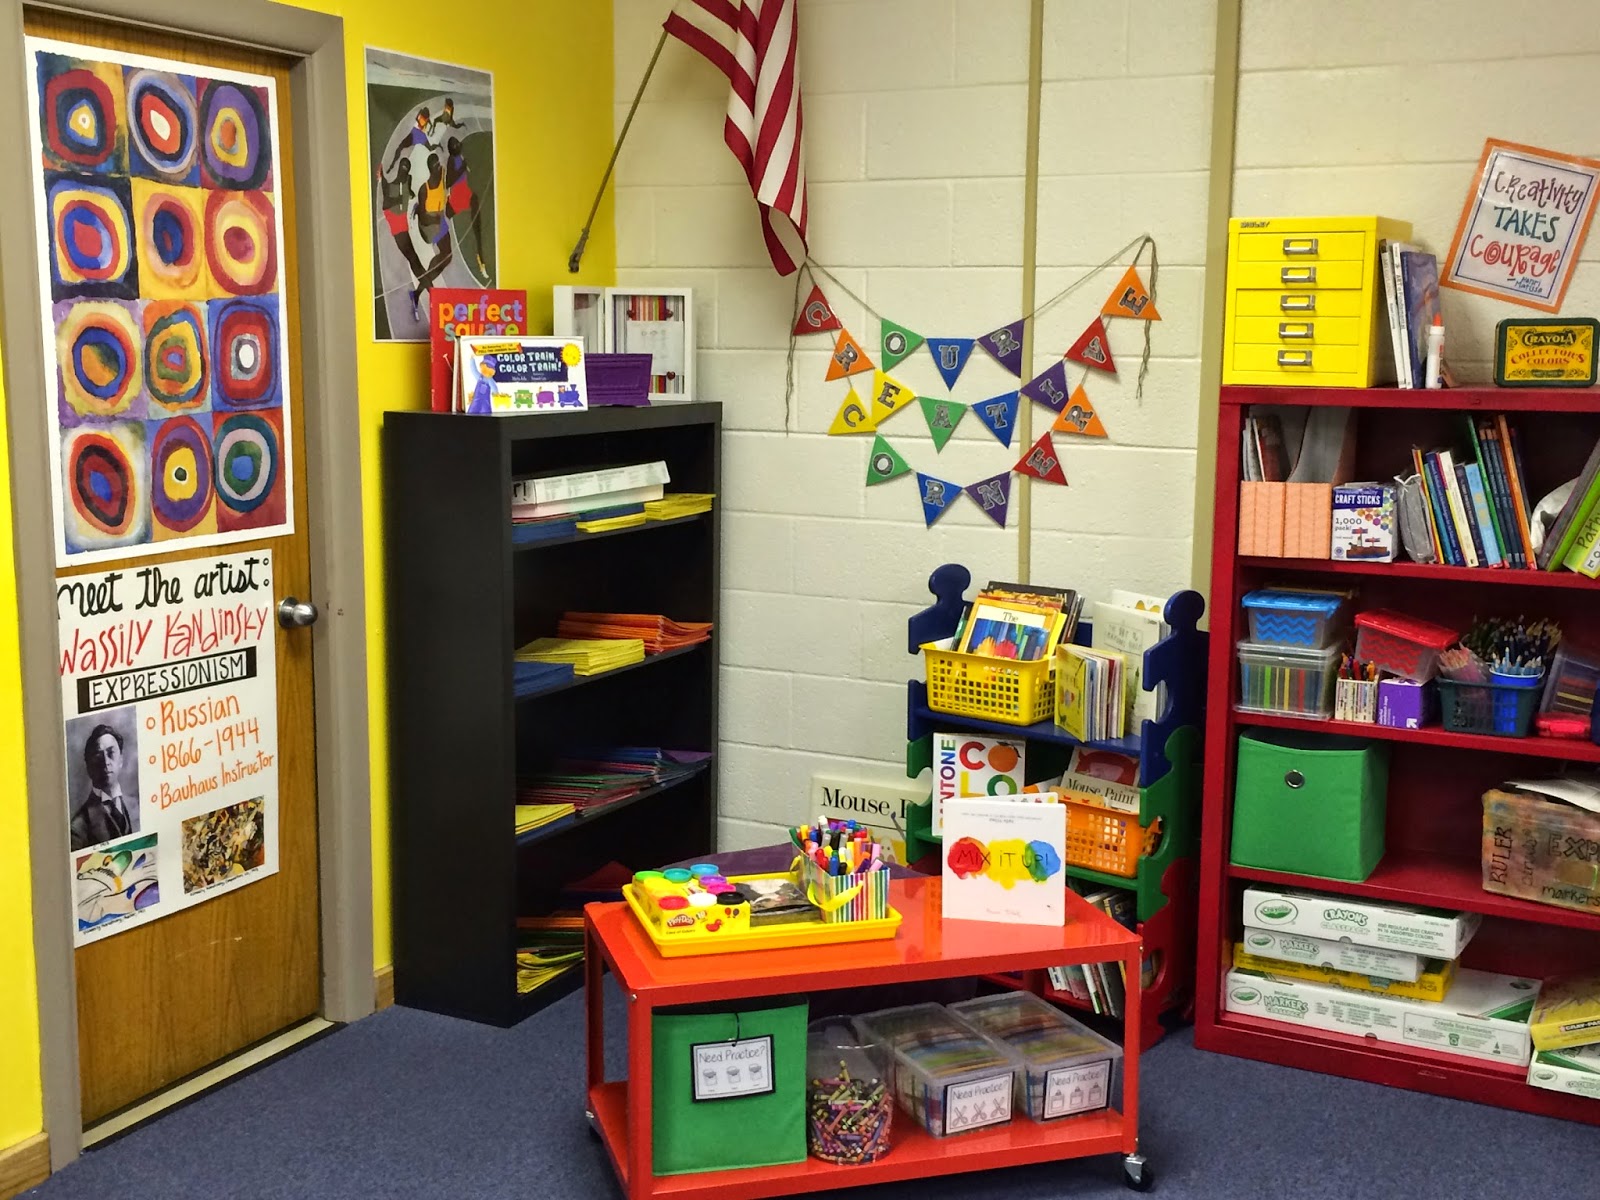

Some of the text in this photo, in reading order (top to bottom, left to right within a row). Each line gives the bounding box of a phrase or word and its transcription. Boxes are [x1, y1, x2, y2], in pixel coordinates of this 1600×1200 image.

[1494, 205, 1560, 243] TAKES
[438, 295, 523, 329] perfect
[444, 322, 520, 342] square
[1524, 333, 1574, 346] CRAYOLA
[497, 352, 526, 363] COLOR
[499, 363, 528, 373] COLOR
[1335, 495, 1381, 505] CRAFT STICKS
[1335, 518, 1362, 526] 1,000
[1003, 611, 1019, 623] The
[59, 619, 153, 675] Wassily
[92, 653, 244, 707] EXPRESSIONISM
[161, 694, 240, 735] Russian
[160, 752, 275, 811] Bauhaus Instructor
[939, 739, 956, 829] NTONE
[1066, 778, 1136, 805] Mouse Paint
[820, 786, 891, 816] Mouse
[957, 849, 991, 867] MIX
[1489, 826, 1513, 885] RULER
[1548, 833, 1600, 864] EXP
[1323, 908, 1369, 927] CRAYONS
[1280, 938, 1321, 954] MARKERS
[1263, 995, 1310, 1013] MARKERS
[699, 1045, 766, 1063] Need Practice?
[1051, 1067, 1106, 1087] Need Practice?
[953, 1079, 1009, 1101] Need Practice?
